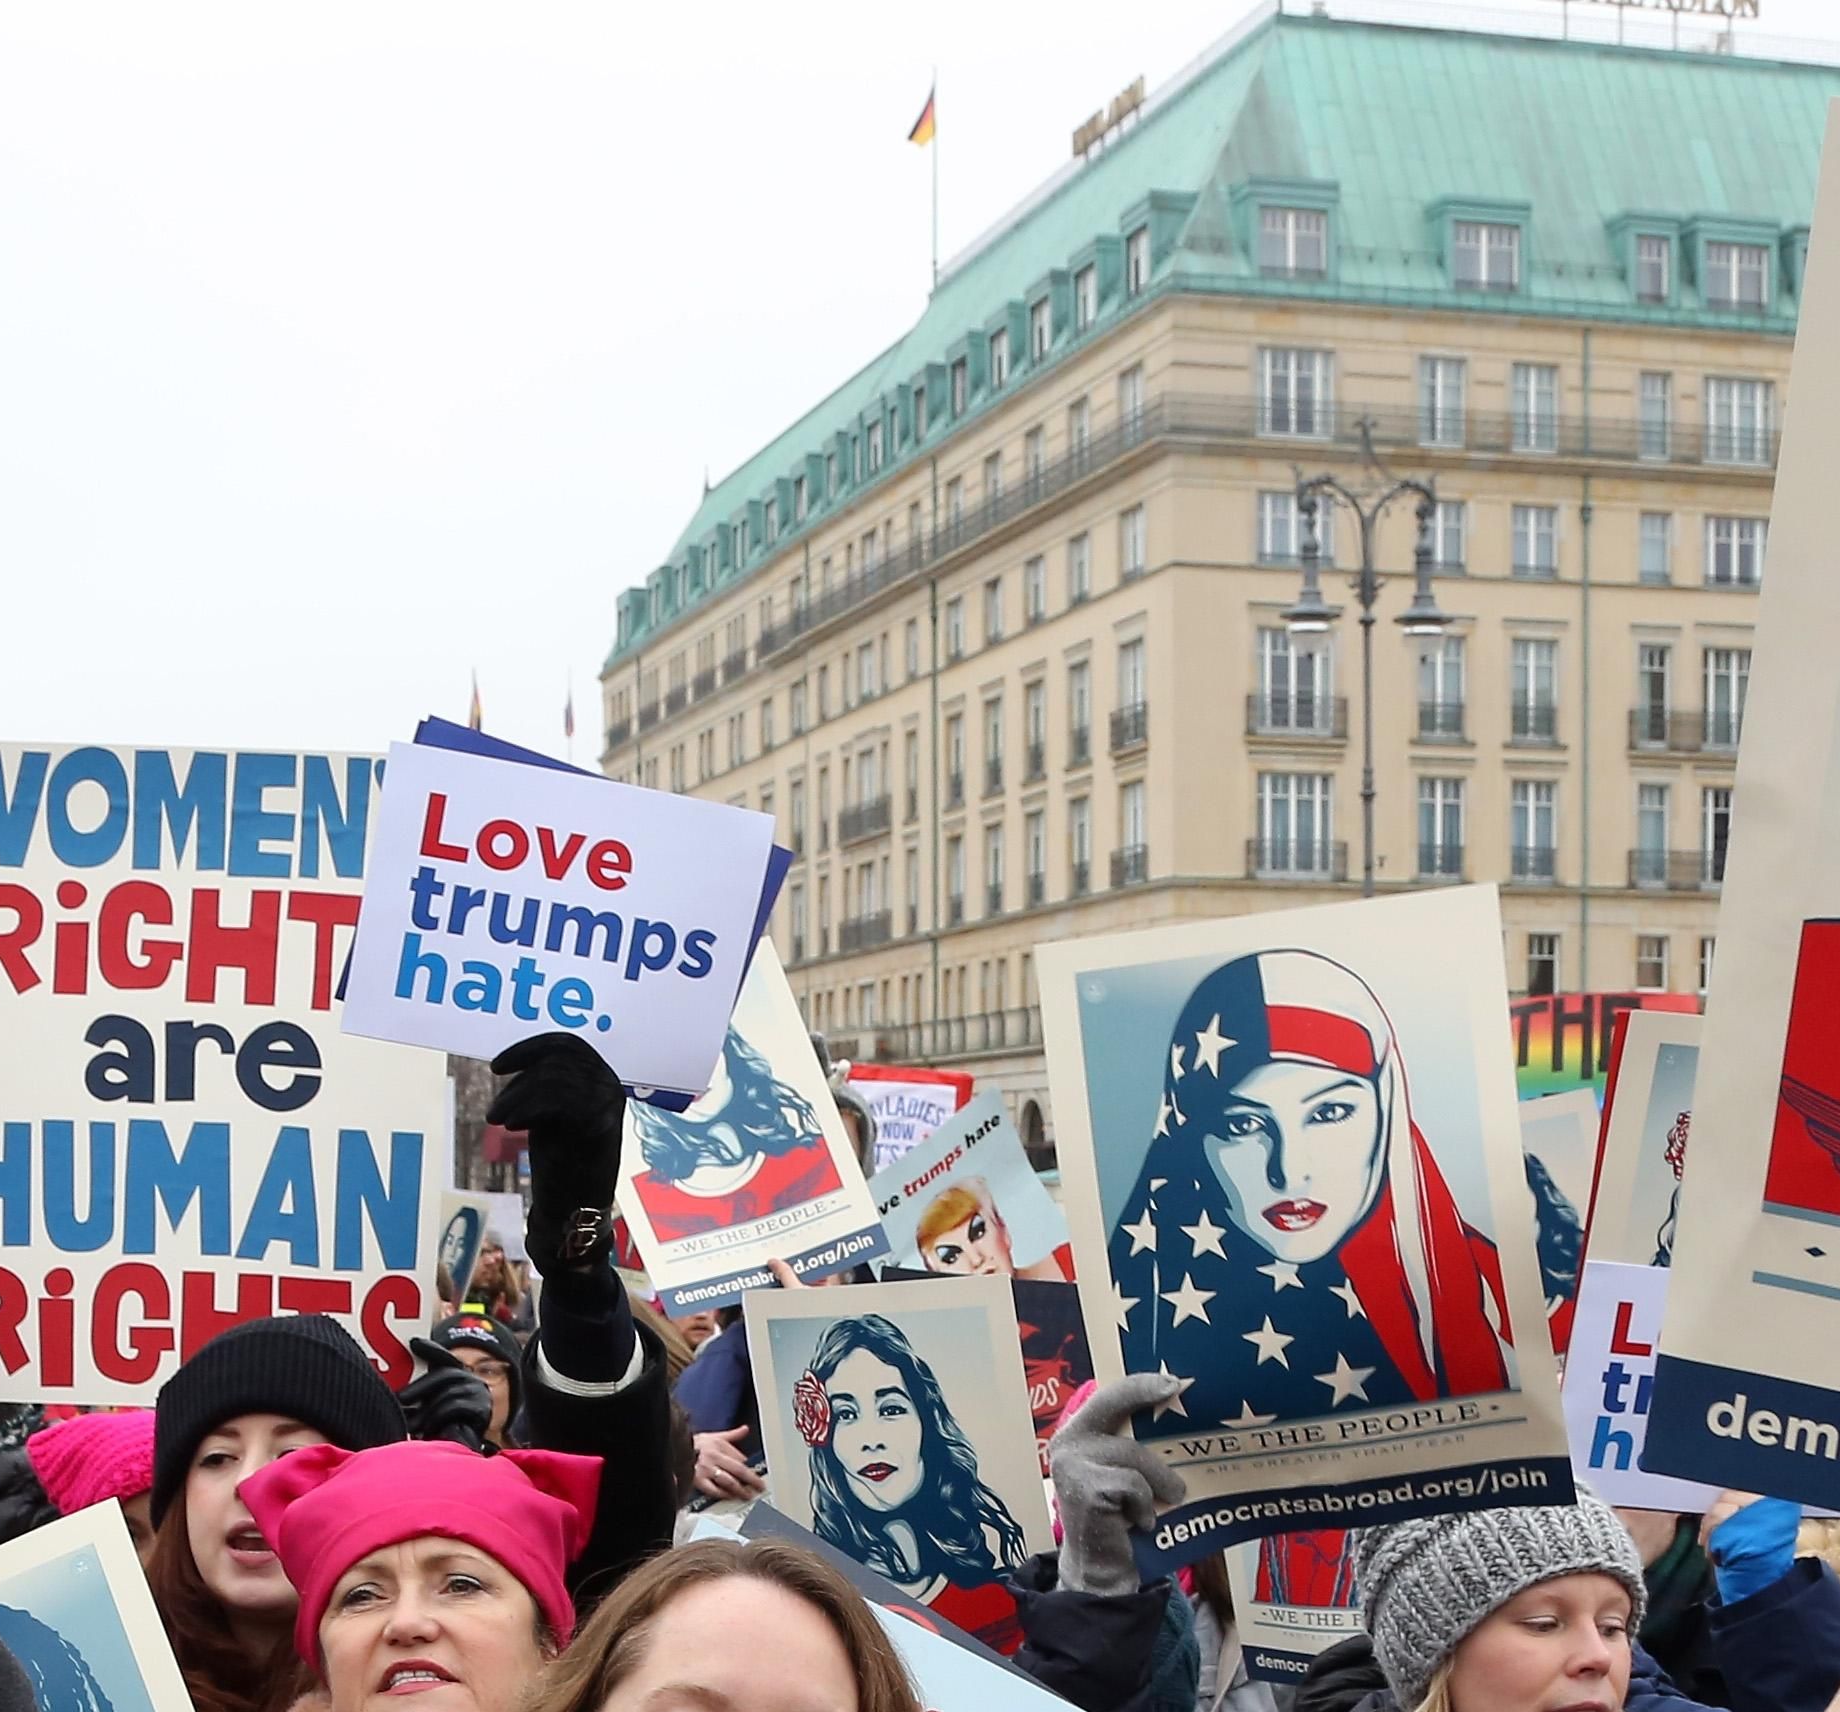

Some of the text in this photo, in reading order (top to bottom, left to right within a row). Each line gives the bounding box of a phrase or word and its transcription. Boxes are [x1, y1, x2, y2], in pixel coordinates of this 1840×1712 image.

[418, 792, 634, 890] Love
[410, 866, 718, 982] trumps
[394, 933, 614, 1033] hate.
[84, 1013, 323, 1113] are
[878, 1114, 1001, 1216] ve trumps hate
[882, 1121, 916, 1140] NOW
[679, 1200, 827, 1255] WE THE PEOPLE
[674, 1233, 875, 1306] democratsabrd.org/join
[1178, 1400, 1481, 1458] WE THE PEOPLE
[1154, 1466, 1549, 1552] democratsabroad.org/join
[1269, 1608, 1298, 1624] WE
[1303, 1612, 1344, 1627] THE
[1255, 1653, 1310, 1674] democr
